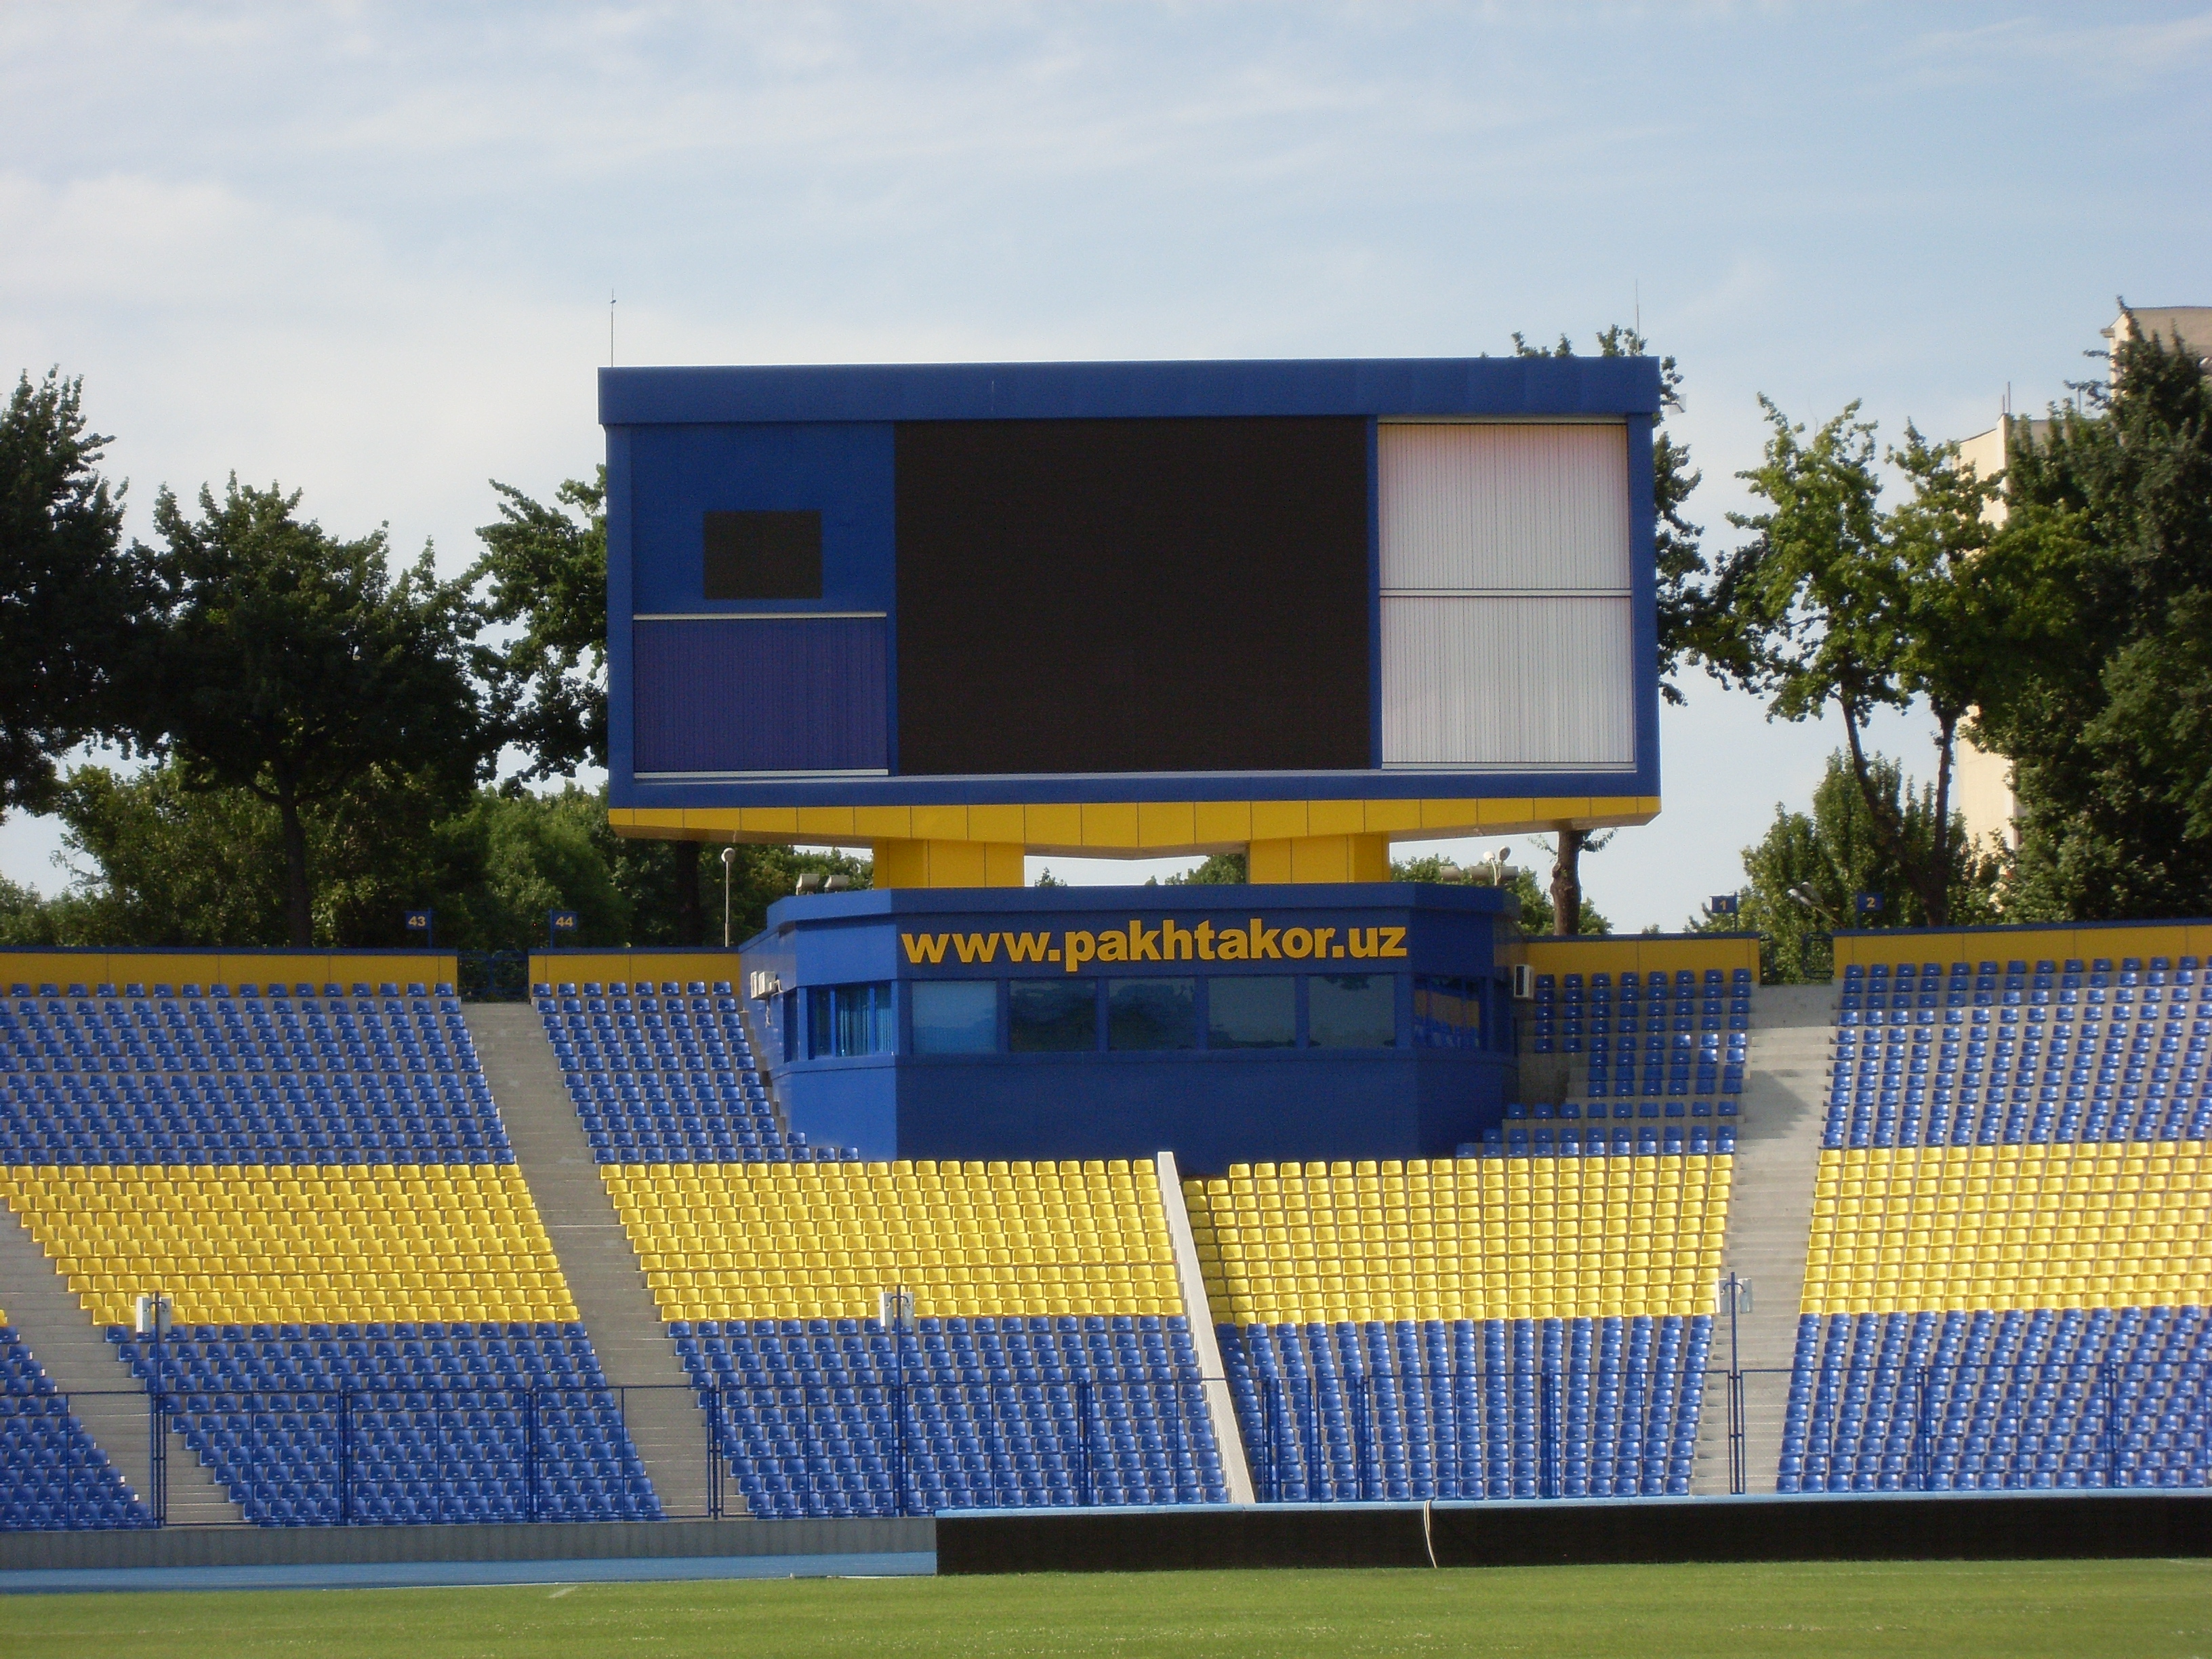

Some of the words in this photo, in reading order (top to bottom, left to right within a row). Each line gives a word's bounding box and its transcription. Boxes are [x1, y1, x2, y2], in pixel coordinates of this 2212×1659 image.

[1719, 899, 1727, 911] 1
[1866, 897, 1875, 908] 2
[408, 916, 426, 927] 43
[556, 916, 573, 927] 44
[901, 919, 1408, 972] www.pakhtakor.uz
